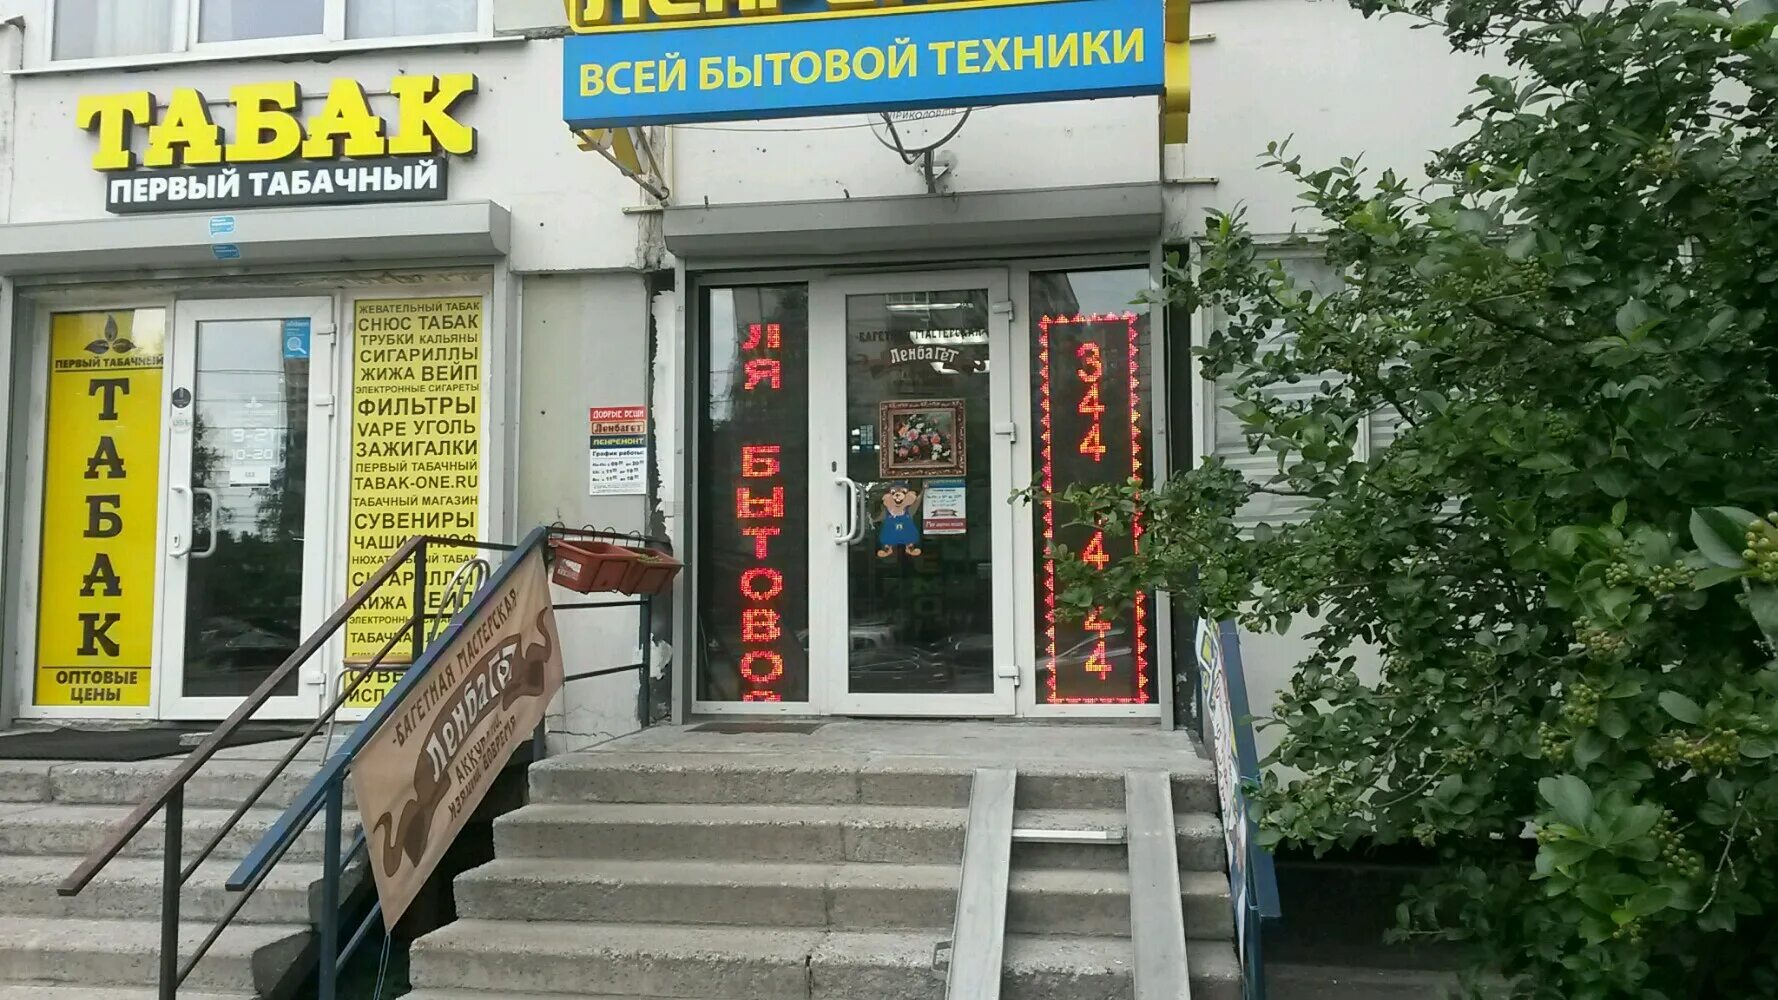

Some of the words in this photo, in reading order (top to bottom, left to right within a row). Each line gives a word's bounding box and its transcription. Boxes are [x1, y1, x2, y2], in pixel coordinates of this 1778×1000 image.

[580, 52, 687, 97] ВСЕЙ
[700, 37, 917, 91] БЫТОВОЙ
[929, 27, 1144, 76] ТЕХНИКИ
[75, 72, 479, 171] ТАБАК
[110, 167, 240, 203] ПЕРВЫЙ
[248, 159, 438, 198] ТАБАЧНЫЙ
[359, 302, 443, 314] ЖЕВАТЕЛЬНЫЙ
[446, 302, 480, 312] ТАБАК
[358, 316, 412, 332] СНЮС
[419, 314, 479, 330] ТАБАК
[360, 334, 414, 346] ТРУБКИ
[419, 333, 478, 344] КАЛЬЯНЫ
[55, 356, 101, 369] ПЕРВЫЙ
[360, 347, 478, 363] СИГАРИЛЛЫ
[361, 367, 415, 381] ЖИЖА
[421, 362, 478, 382] ВЕЙП
[355, 384, 426, 394] ЭЛЕКТРОННЫЕ
[428, 383, 480, 392] СИГАРЕТЫ
[358, 396, 476, 416] ФИЛЬТРЫ
[357, 421, 407, 437] VAPE
[413, 419, 476, 435] УГОЛЬ
[356, 439, 478, 457] ЗАЖИГАЛКИ
[355, 460, 408, 473] ПЕРВЫЙ
[412, 458, 478, 472] ТАБАЧНЫЙ
[354, 475, 478, 490] TABAK-ONE.RU
[353, 494, 418, 507] ТАБАЧНЫЙ
[421, 495, 478, 506] МАГАЗИН
[77, 377, 130, 658] ТАБАК
[354, 512, 475, 529] СУВЕНИРЫ
[56, 670, 138, 685] ОПТОВЫЕ
[70, 688, 121, 704] ЦЕНЫ
